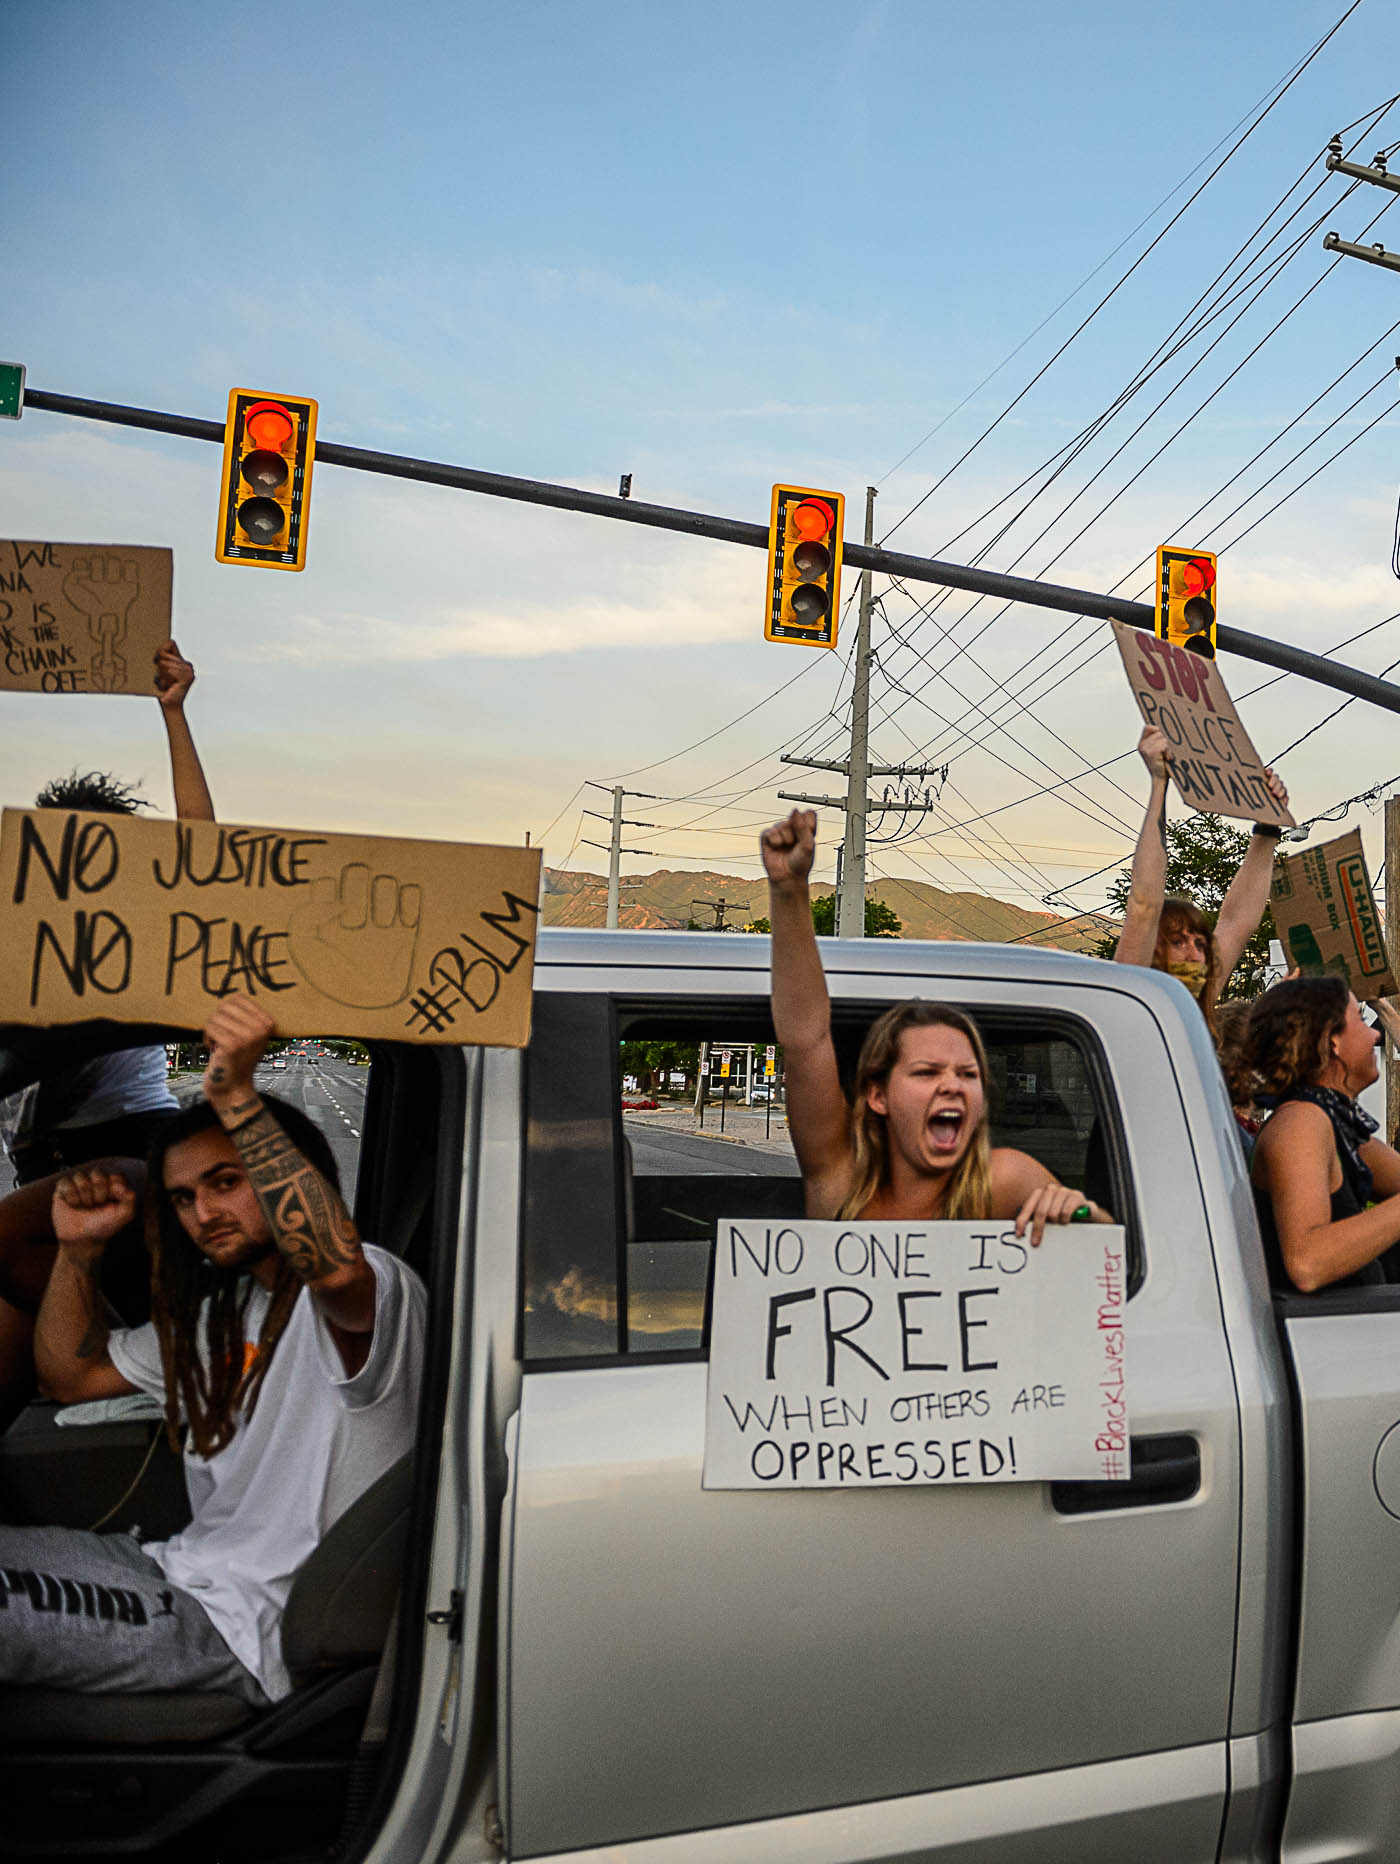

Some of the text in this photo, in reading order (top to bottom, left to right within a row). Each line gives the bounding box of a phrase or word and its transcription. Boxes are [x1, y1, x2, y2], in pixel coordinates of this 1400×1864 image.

[33, 602, 56, 624] IS
[1135, 631, 1216, 713] STOP
[13, 814, 327, 904] NO JUSTICE
[1326, 903, 1340, 930] BOX
[1347, 863, 1380, 968] U-HAUL
[30, 909, 297, 1007] NO PEACE
[405, 890, 539, 1034] #BLM
[729, 1226, 1028, 1278] NO ONE IS
[766, 1286, 1000, 1387] FREE
[723, 1384, 1067, 1432] WHEN OTHERS ARE
[751, 1436, 1017, 1481] OPPRESSED!
